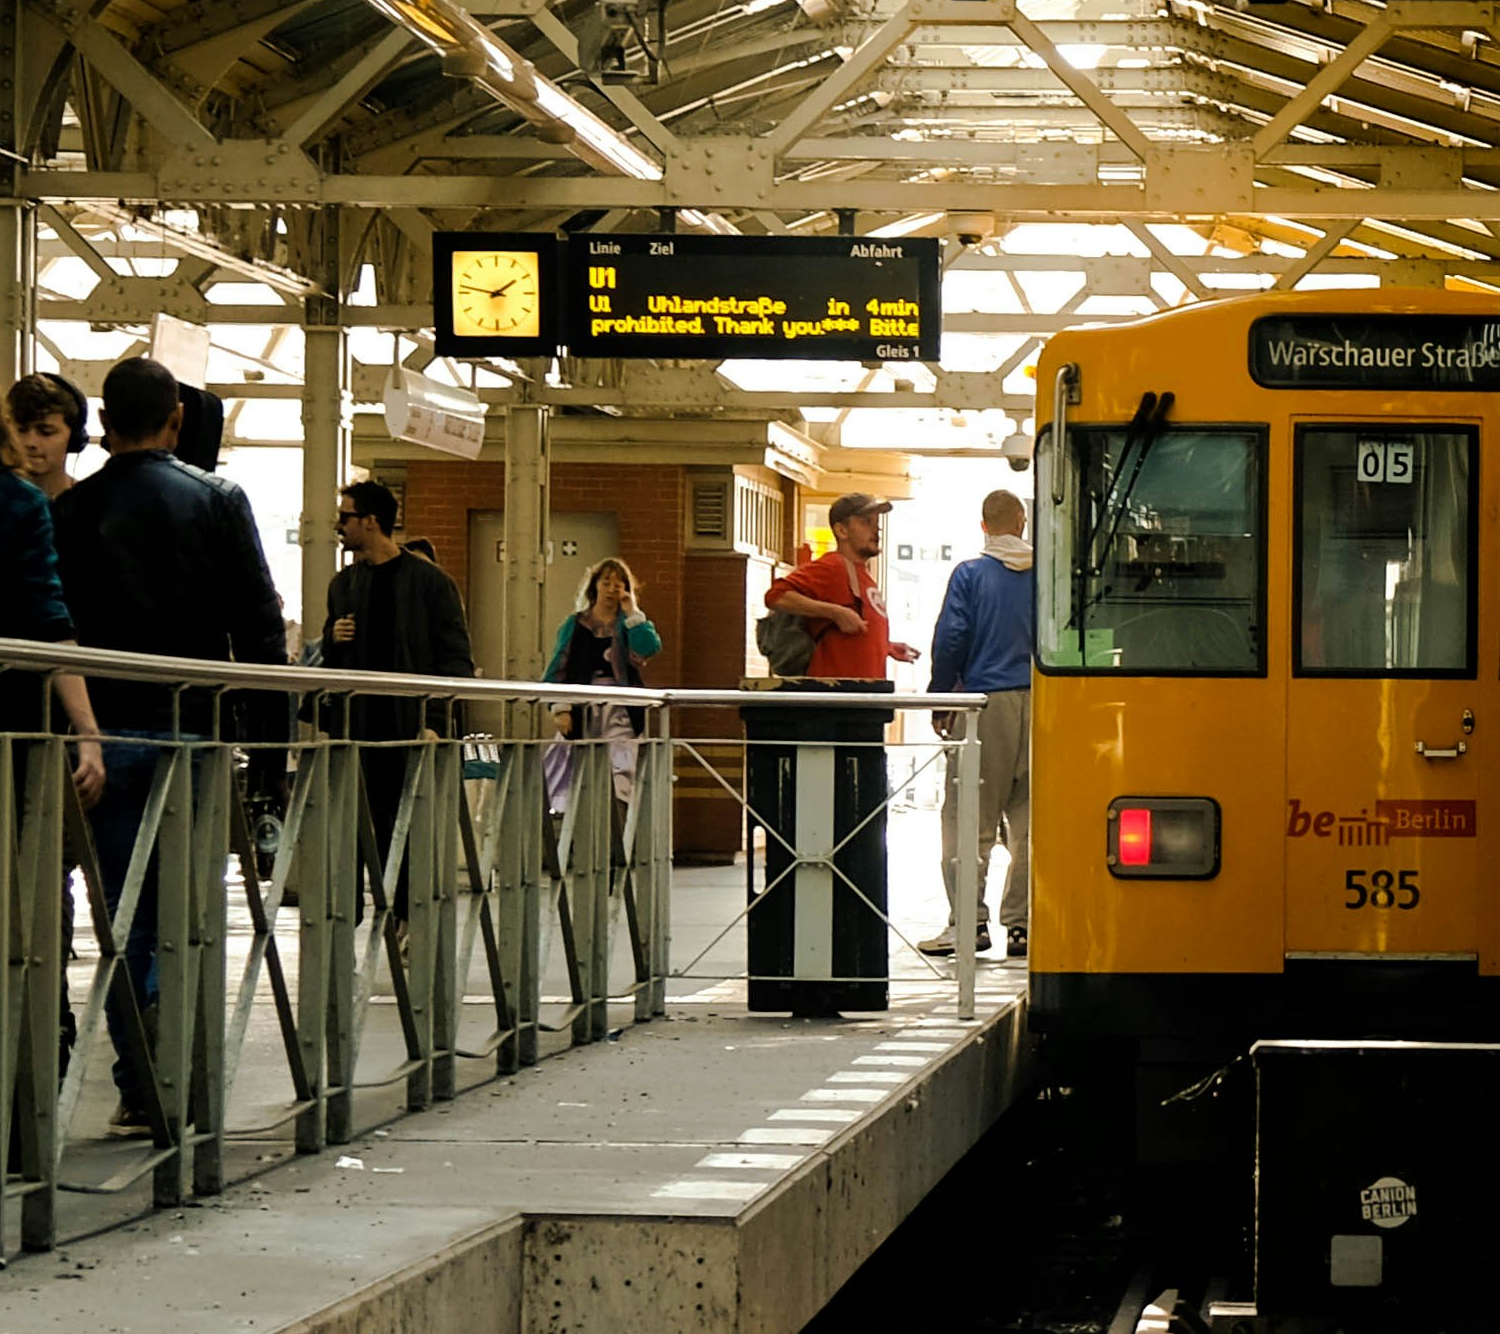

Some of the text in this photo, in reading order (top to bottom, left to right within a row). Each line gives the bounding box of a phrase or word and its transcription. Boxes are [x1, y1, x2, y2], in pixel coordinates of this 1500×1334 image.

[589, 242, 902, 259] Linie Ziel Abfahrt
[589, 266, 616, 289] U1
[647, 294, 787, 318] Uhlandstraße
[827, 297, 850, 316] in
[591, 316, 705, 336] prohibited.
[713, 317, 774, 335] Thank
[869, 318, 919, 337] Bitte
[876, 344, 920, 358] Gleis 1
[1268, 340, 1500, 369] Warschauer Straße
[1287, 799, 1466, 837] be Berlin
[1345, 870, 1420, 909] 585
[1362, 1201, 1417, 1219] BERLIN
